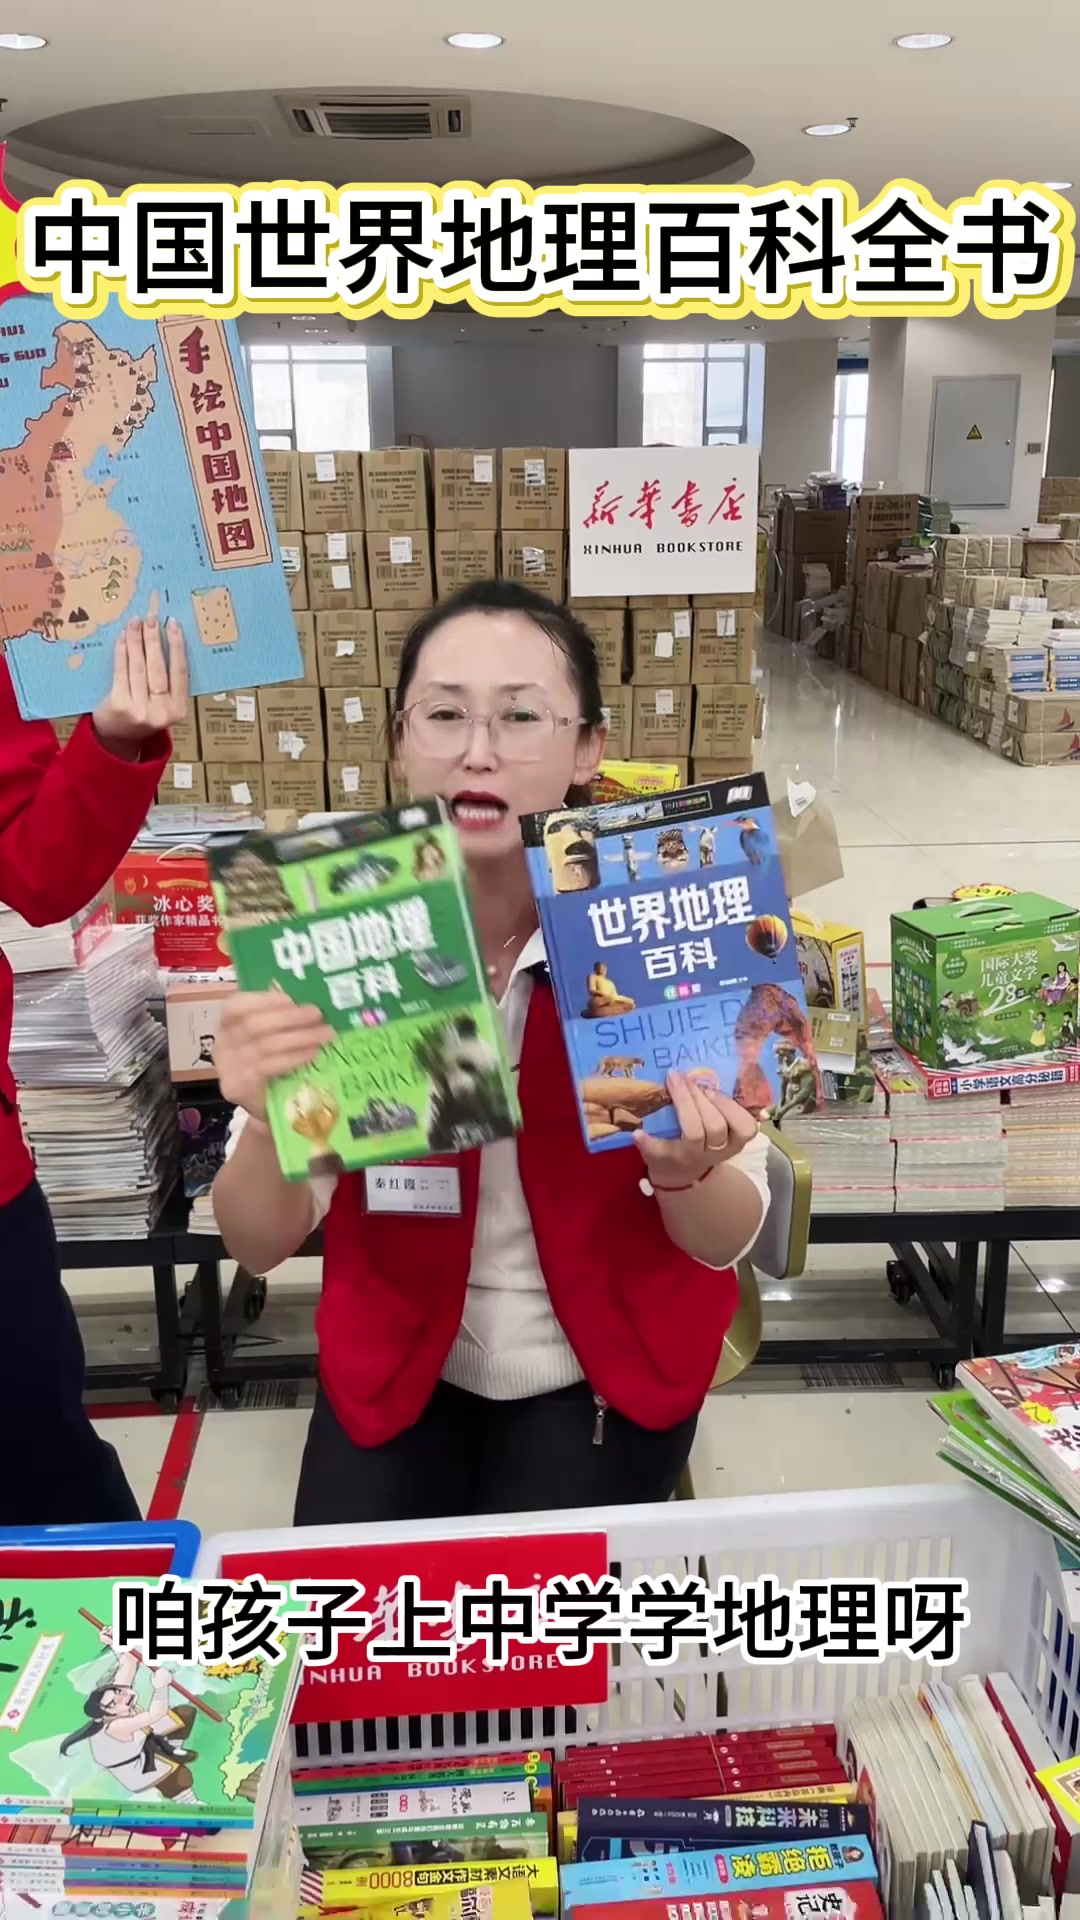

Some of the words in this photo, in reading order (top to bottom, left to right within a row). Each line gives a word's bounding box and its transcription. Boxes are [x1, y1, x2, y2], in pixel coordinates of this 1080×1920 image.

[179, 325, 255, 554] 手绘中国地图
[583, 543, 642, 555] XINHUA
[656, 540, 743, 553] BOOKSTORE
[153, 894, 215, 912] 冰心奖
[588, 875, 756, 948] 世界地理
[272, 893, 437, 980] 中国地理
[641, 937, 718, 980] 百科
[980, 949, 1038, 973] 国际大奖
[980, 965, 1038, 988] 儿童文学
[595, 1004, 710, 1048] SHIJIE
[299, 1664, 382, 1686] INHUA
[735, 1806, 819, 1829] 未来科技
[730, 1843, 834, 1881] 拒绝霸凌
[795, 1892, 843, 1914] 史记
